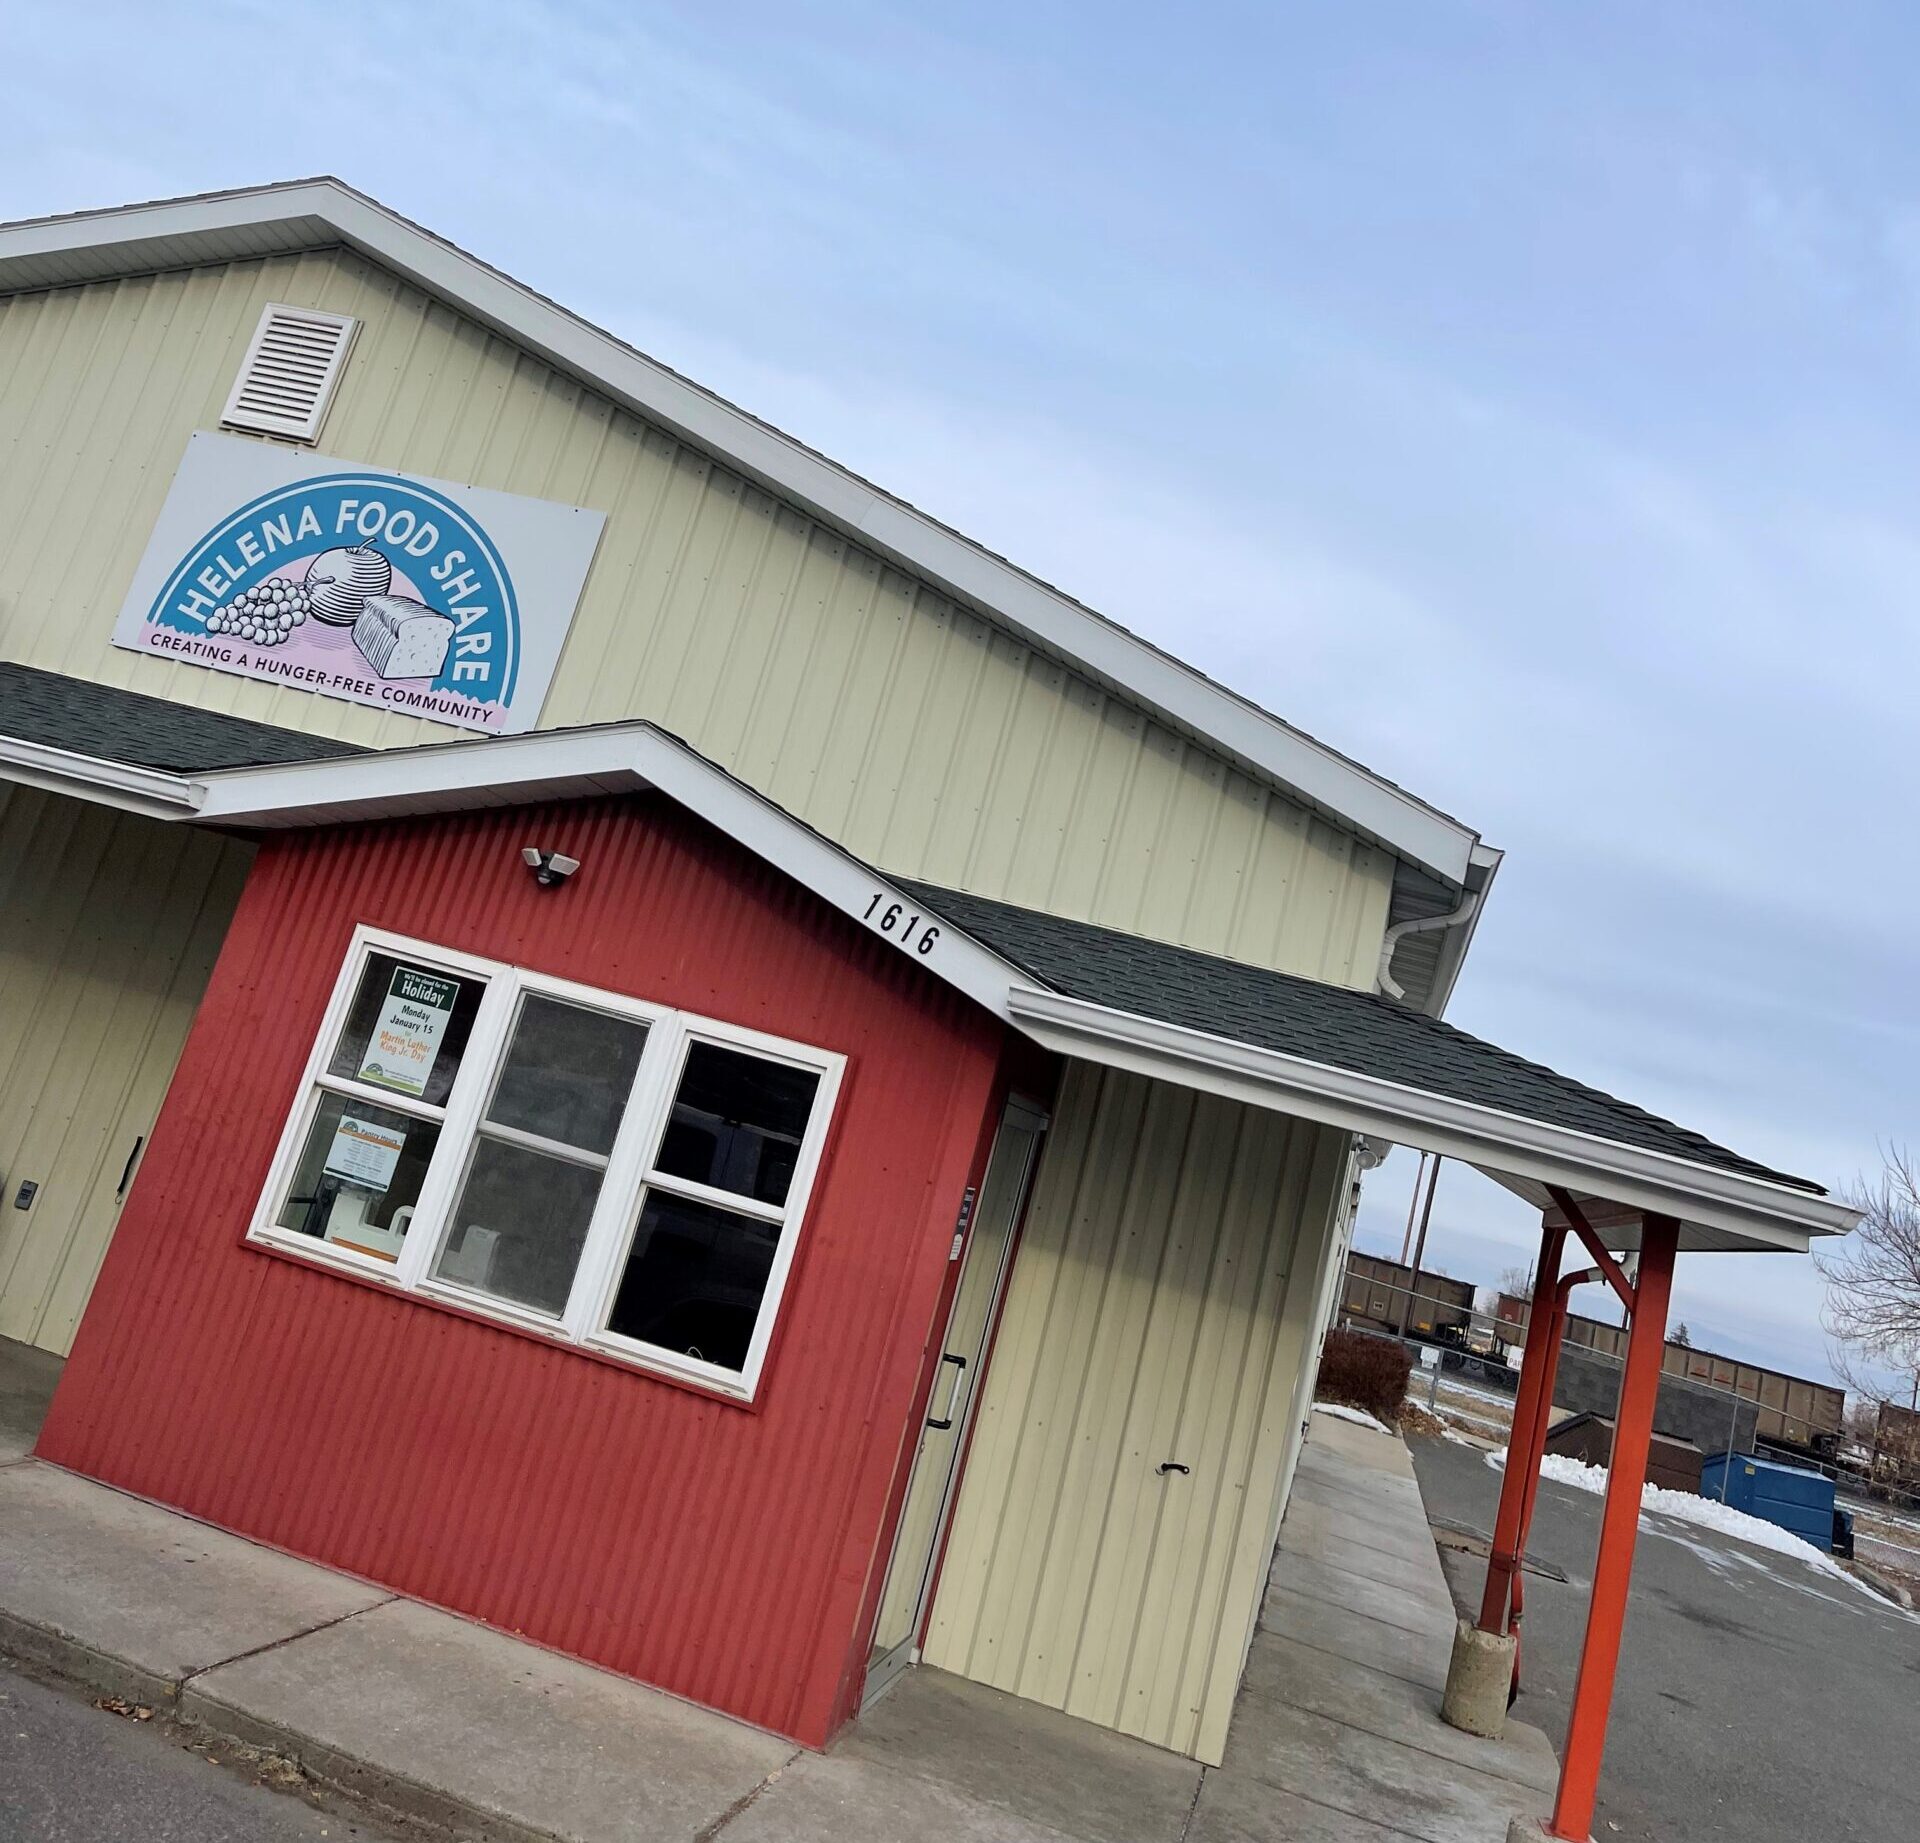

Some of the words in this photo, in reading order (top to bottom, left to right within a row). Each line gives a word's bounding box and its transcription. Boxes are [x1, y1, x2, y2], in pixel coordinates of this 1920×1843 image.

[177, 504, 323, 622] HELENA
[336, 498, 440, 558] FOOD
[430, 550, 493, 682] SHARE
[149, 633, 233, 663] CREATING
[236, 652, 249, 667] A
[255, 657, 375, 697] HUNGER-FREE
[381, 686, 495, 723] COMMUNITY
[863, 893, 940, 955] 1616
[401, 982, 445, 1007] Holiday
[390, 1014, 421, 1032] January
[423, 1024, 434, 1034] 15
[401, 1005, 431, 1021] Monday
[380, 1030, 406, 1046] Martin
[407, 1037, 432, 1054] Luther
[380, 1041, 398, 1056] King
[398, 1046, 409, 1057] Jr.
[411, 1049, 426, 1064] Day
